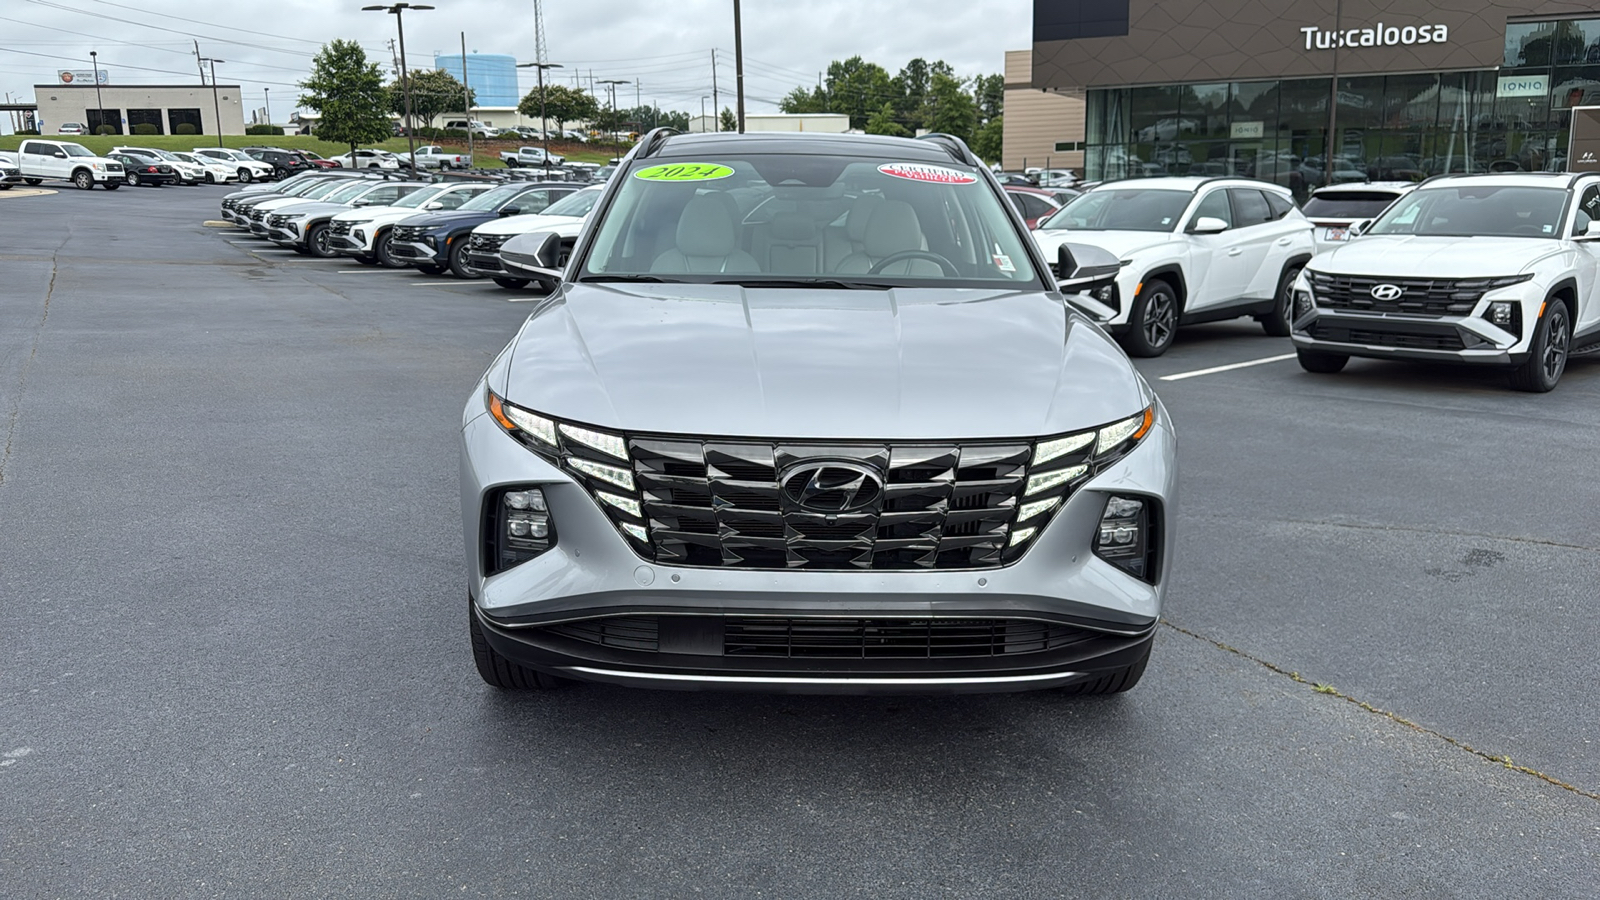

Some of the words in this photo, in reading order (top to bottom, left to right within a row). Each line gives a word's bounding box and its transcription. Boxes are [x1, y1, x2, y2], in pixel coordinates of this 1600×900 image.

[1300, 22, 1448, 50] Tuscaloosa
[1503, 81, 1542, 91] IONIQ
[646, 166, 720, 178] 2024
[889, 164, 965, 178] CERTIFIED
